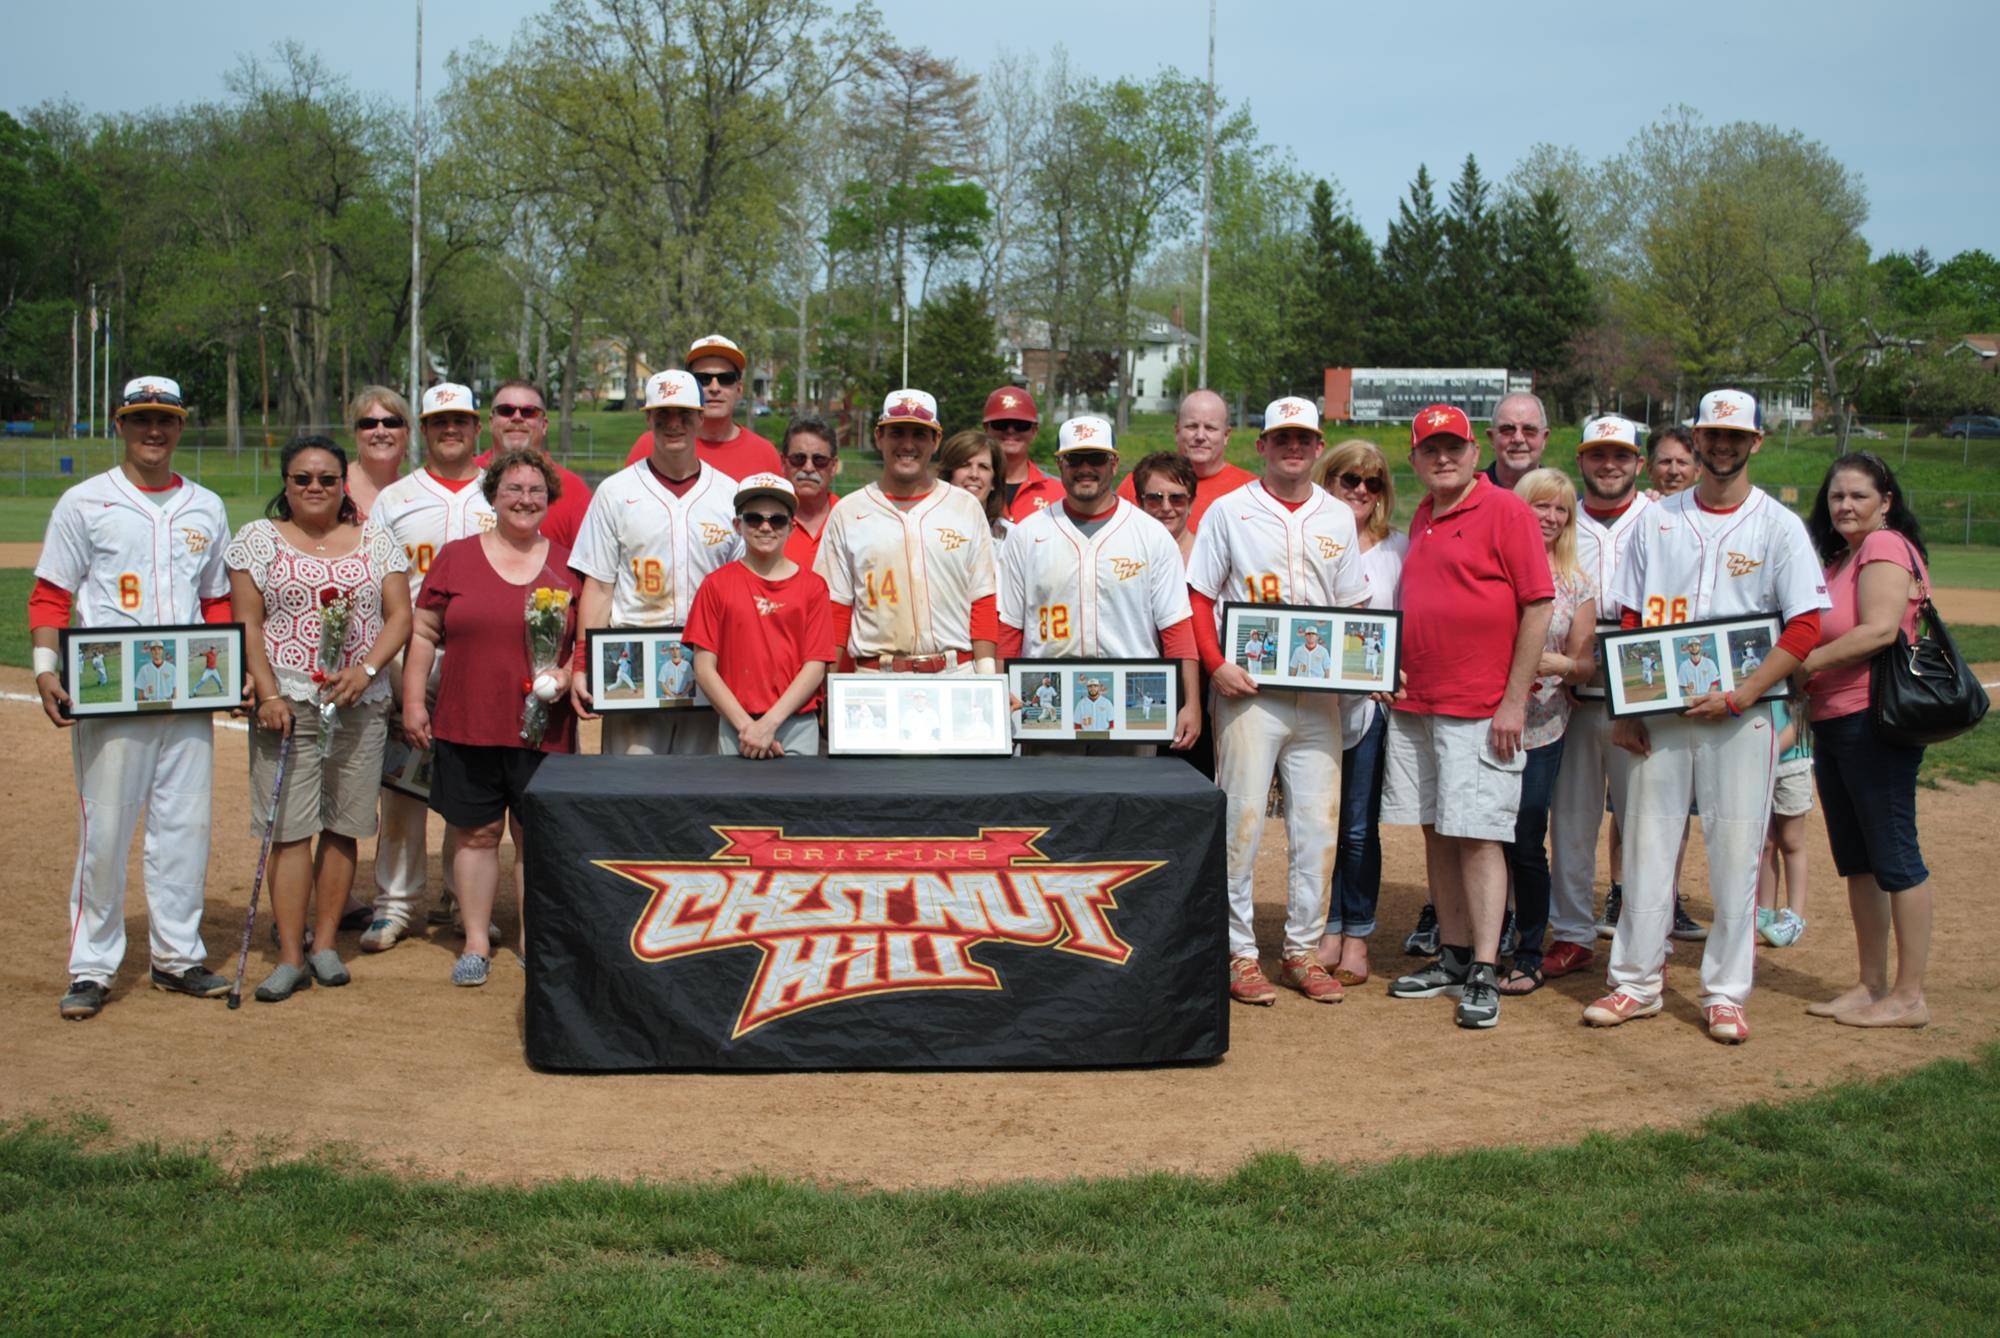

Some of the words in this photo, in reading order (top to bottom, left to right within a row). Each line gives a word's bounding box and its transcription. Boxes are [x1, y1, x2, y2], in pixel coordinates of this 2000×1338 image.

[1353, 399, 1383, 408] VISITOR
[1356, 409, 1379, 418] HOME
[119, 573, 142, 610] 6
[632, 557, 664, 594] 16
[865, 568, 898, 608] 14
[1244, 572, 1281, 604] 18
[1644, 595, 1689, 627] 36
[772, 847, 989, 862] GRIFFINS
[641, 871, 1121, 954] CHESTNUT
[750, 936, 978, 1014] HILL
